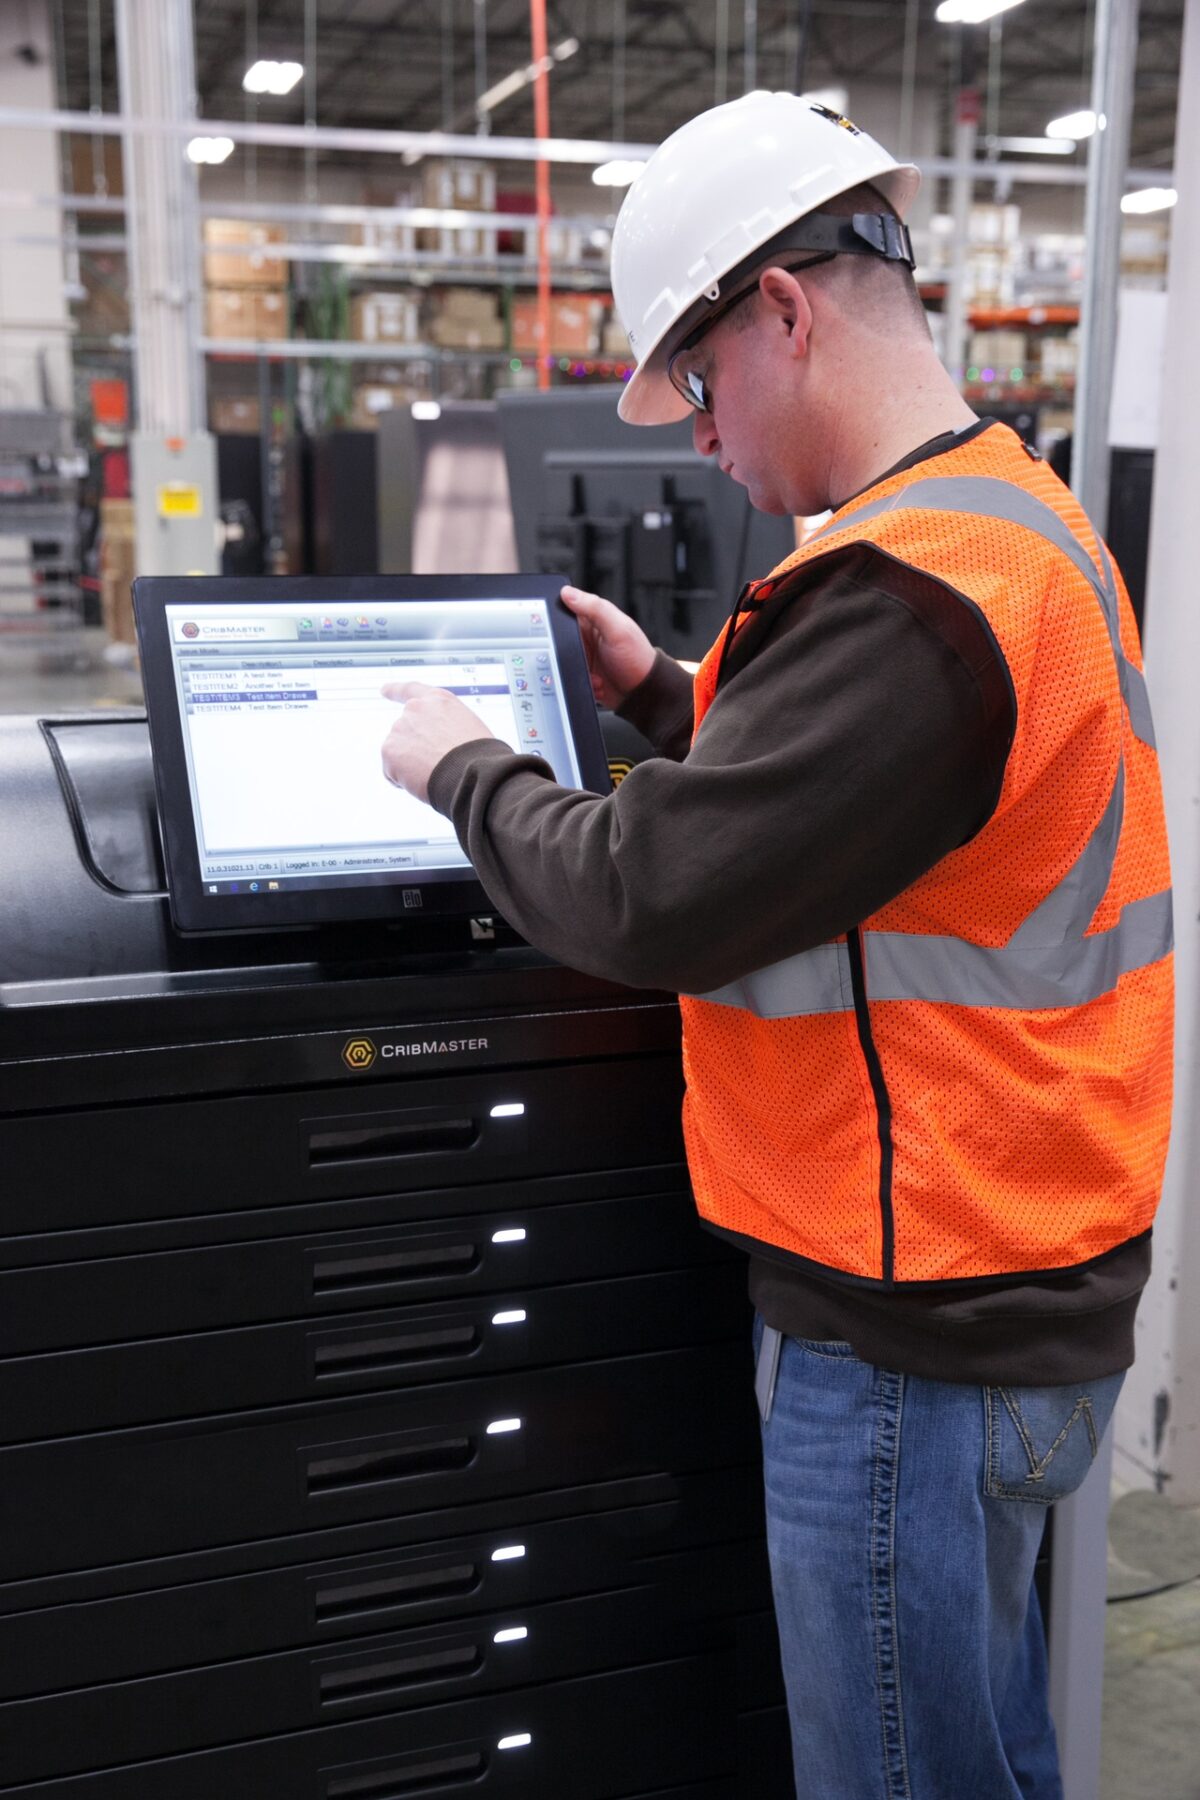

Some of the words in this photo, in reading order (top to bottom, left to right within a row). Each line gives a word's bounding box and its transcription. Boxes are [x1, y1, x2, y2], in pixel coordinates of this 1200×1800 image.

[196, 704, 242, 712] TESTITEM4
[286, 861, 310, 870] Logged
[389, 856, 411, 865] System
